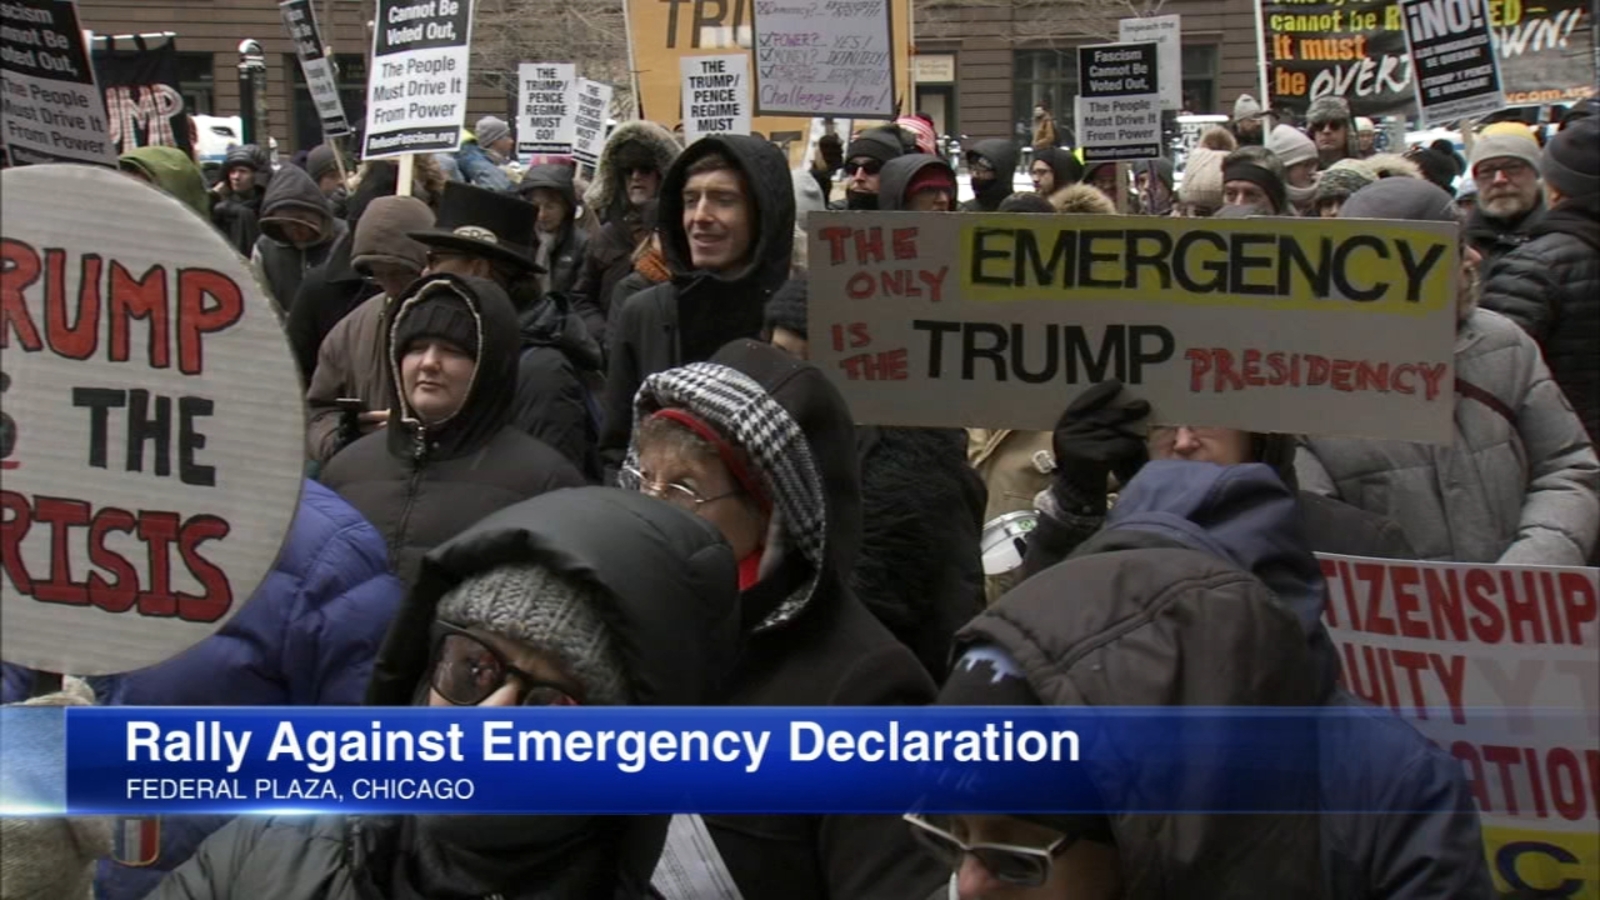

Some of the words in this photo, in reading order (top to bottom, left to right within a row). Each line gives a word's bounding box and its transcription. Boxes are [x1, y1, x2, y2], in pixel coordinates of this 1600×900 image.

[0, 2, 53, 24] scism
[389, 1, 436, 23] Cannot
[439, 0, 458, 16] Be
[1270, 10, 1343, 32] cannot
[1350, 11, 1376, 31] be
[43, 30, 69, 49] Be
[387, 24, 422, 45] Voted
[426, 21, 456, 40] Out,
[0, 46, 37, 67] oted
[1094, 50, 1143, 62] Fascism
[1273, 34, 1294, 60] It
[1300, 34, 1368, 60] must
[382, 63, 404, 78] The
[407, 56, 456, 75] People
[536, 68, 557, 79] THE
[701, 60, 726, 74] THE
[1089, 65, 1130, 77] Cannot
[1132, 63, 1148, 75] Be
[374, 83, 404, 102] Must
[408, 80, 447, 97] Drive
[451, 78, 461, 93] It
[525, 80, 569, 91] TRUMP/
[689, 73, 740, 89] TRUMP/
[1089, 79, 1122, 91] Voted
[1276, 67, 1305, 95] be
[29, 84, 90, 108] People
[528, 92, 564, 103] PENCE
[694, 89, 736, 103] PENCE
[1089, 102, 1110, 113] The
[1113, 100, 1150, 114] People
[40, 107, 86, 130] Drive
[89, 115, 104, 133] It
[374, 108, 405, 124] From
[409, 103, 457, 119] Power
[525, 104, 567, 116] REGIME
[691, 103, 740, 118] REGIME
[1115, 114, 1145, 126] Drive
[530, 117, 561, 128] MUST
[697, 118, 734, 131] MUST
[7, 120, 49, 144] From
[51, 131, 105, 154] Power
[535, 129, 555, 140] GO!
[1087, 130, 1115, 141] From
[1118, 129, 1154, 140] Power
[818, 226, 919, 266] THE
[970, 226, 1448, 303] EMERGENCY
[845, 266, 948, 301] ONLY
[0, 237, 244, 375] RUMP
[831, 322, 872, 352] IS
[840, 348, 909, 382] THE
[913, 319, 1176, 385] TRUMP
[1184, 347, 1448, 401] PRESIDENCY
[72, 387, 216, 487] THE
[0, 489, 233, 623] RISIS
[1319, 558, 1598, 646] TIZENSHIP
[1341, 642, 1467, 726] UITY
